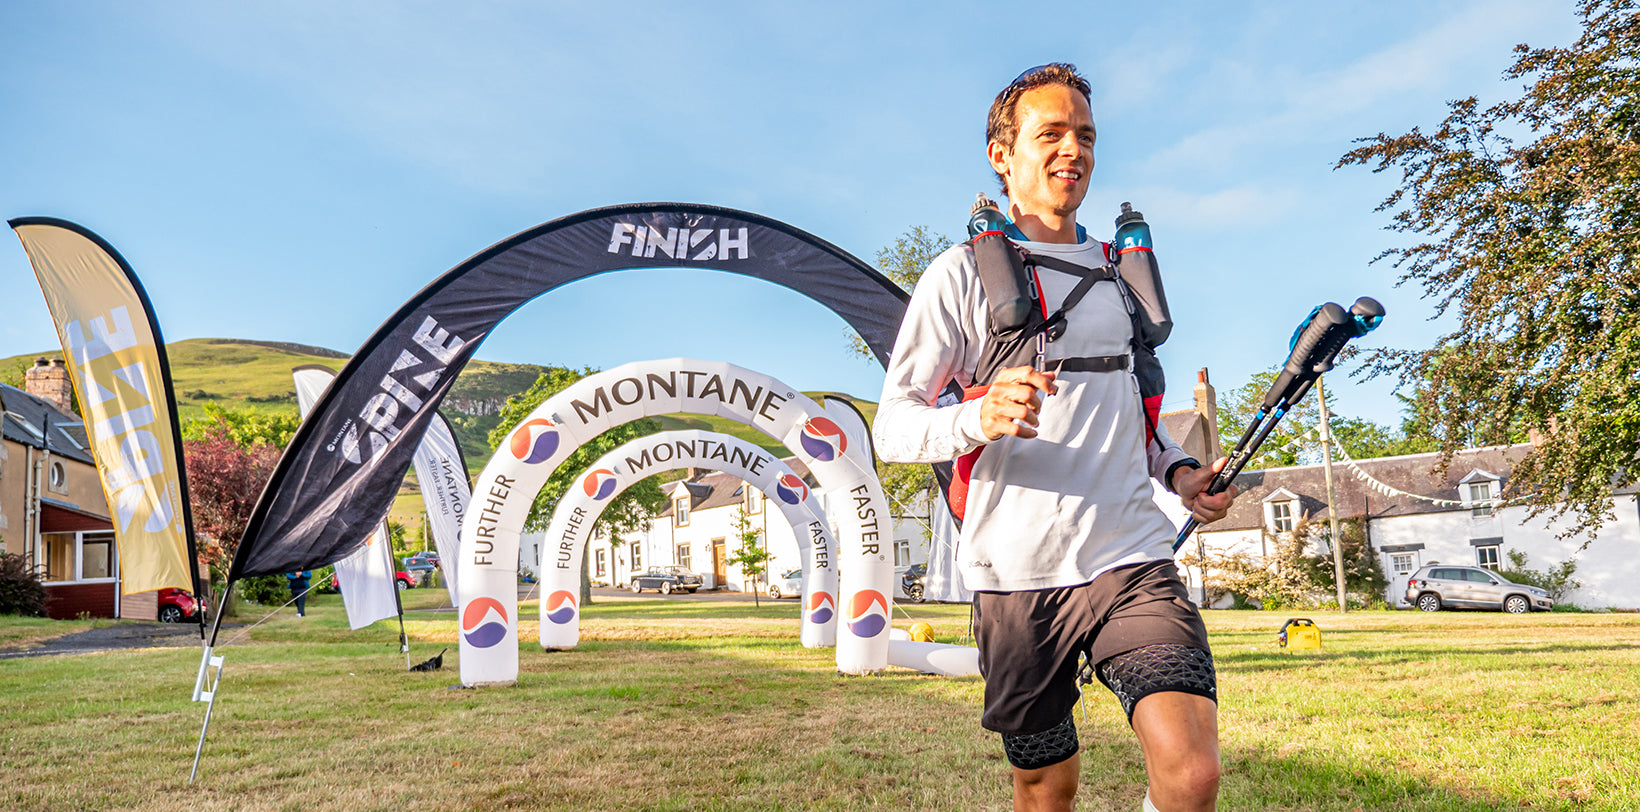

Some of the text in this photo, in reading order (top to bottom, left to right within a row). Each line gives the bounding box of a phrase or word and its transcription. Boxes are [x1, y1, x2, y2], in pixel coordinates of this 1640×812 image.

[608, 223, 748, 260] FINISH
[342, 315, 466, 467] SPINE
[474, 474, 516, 566] FURTHER
[557, 506, 587, 569] FURTHER
